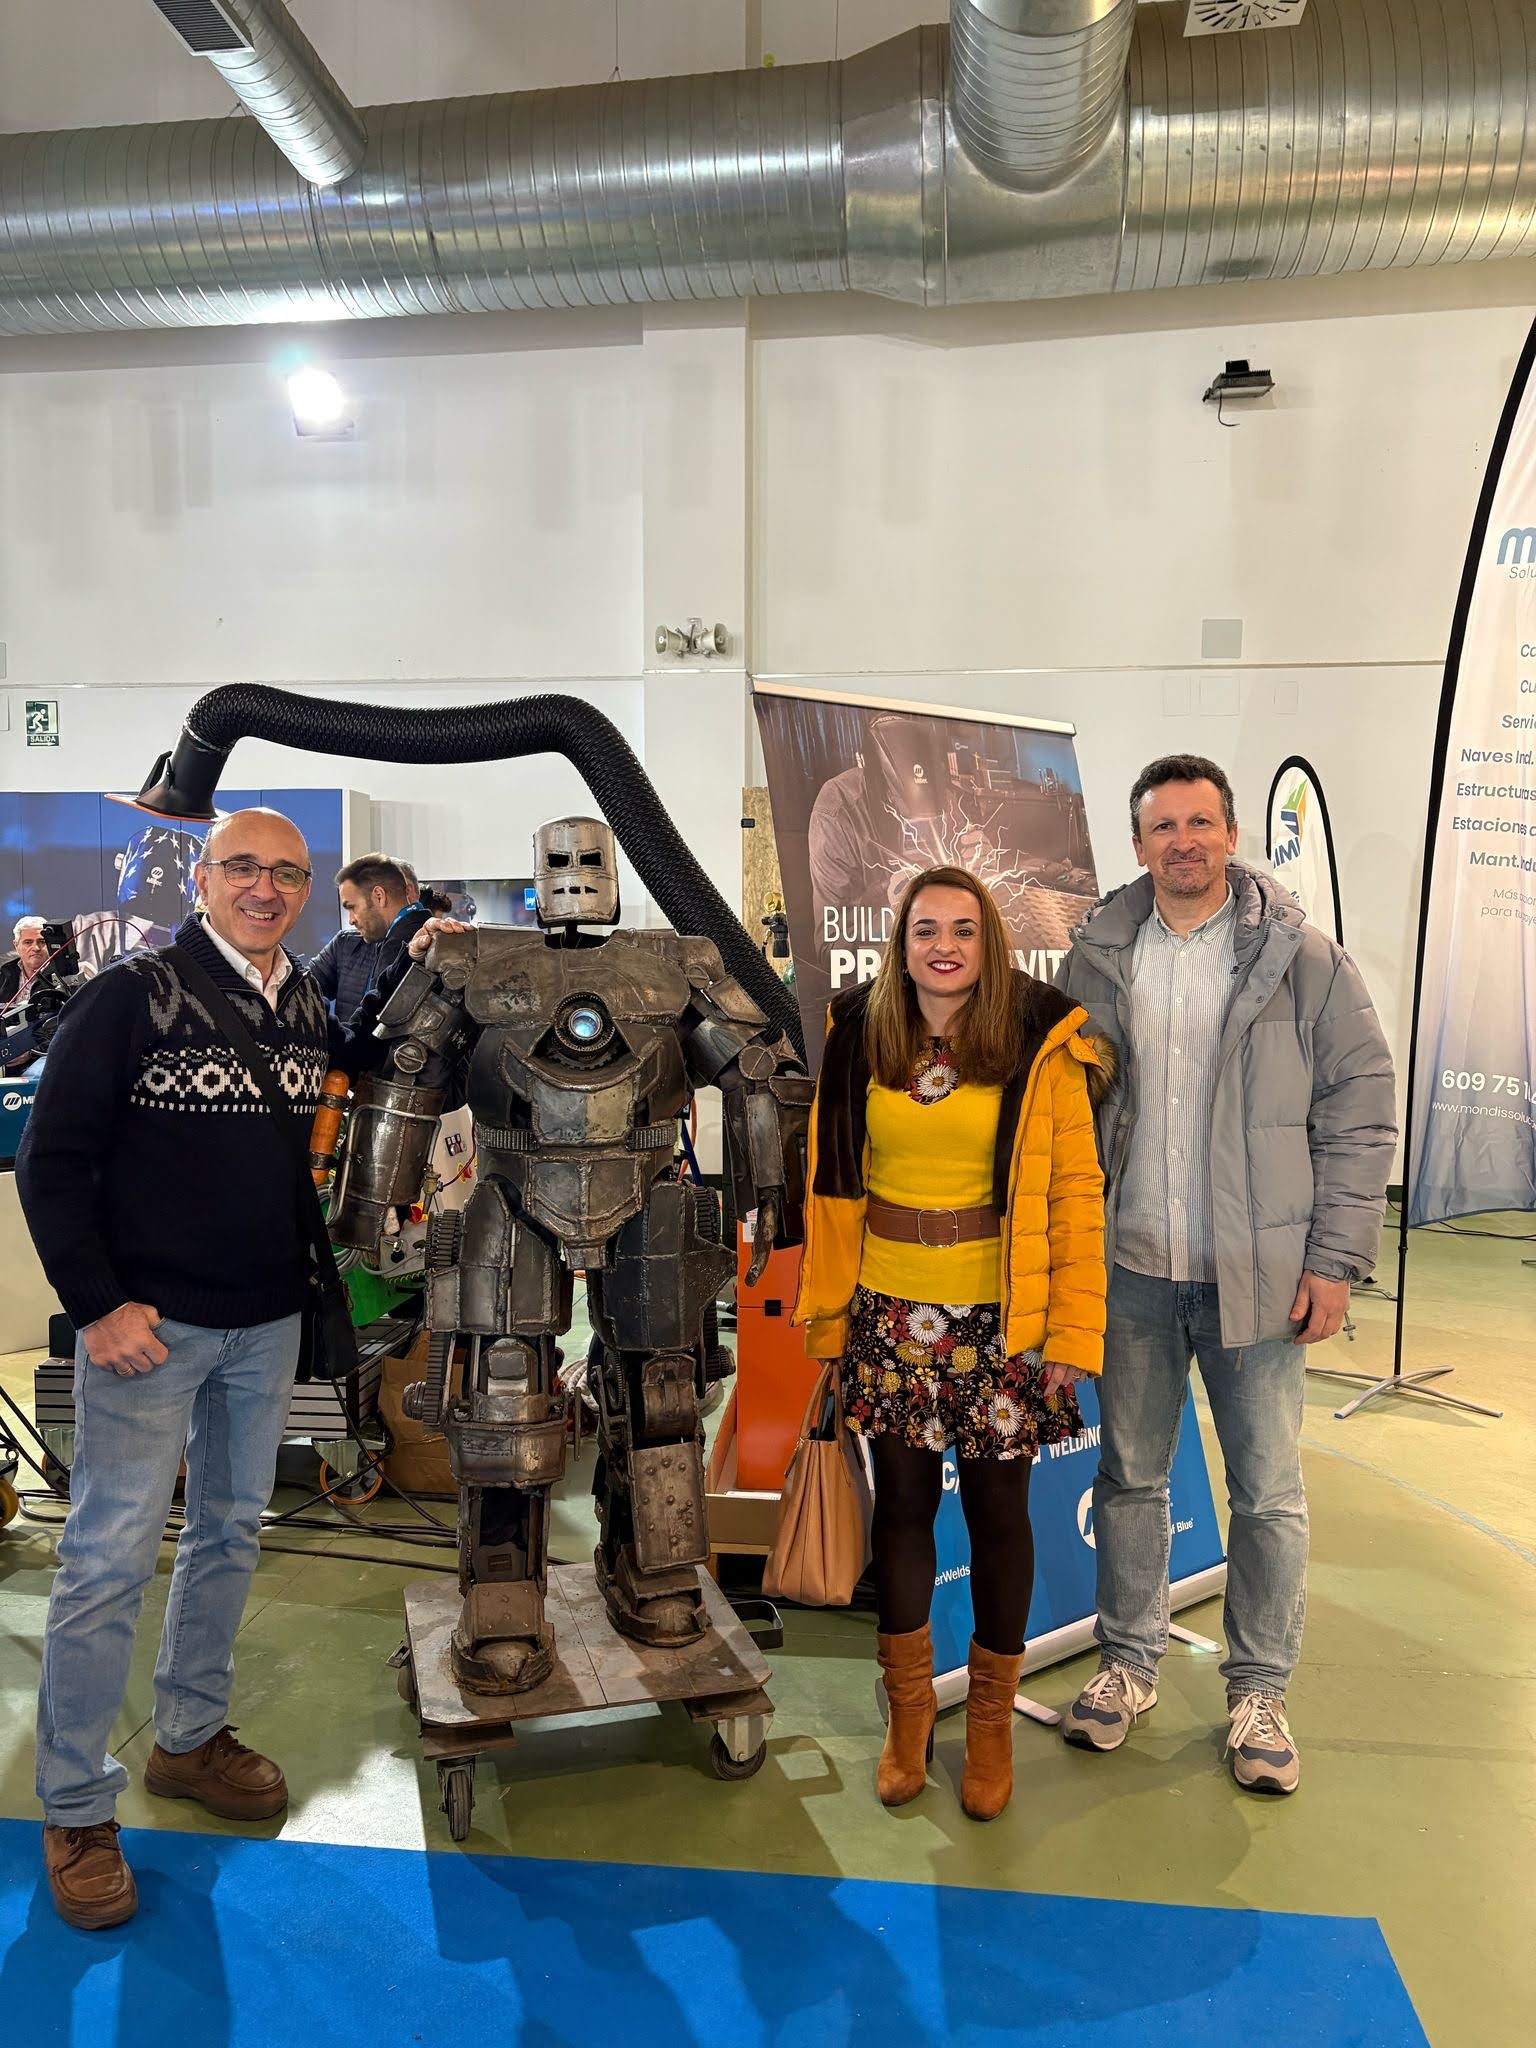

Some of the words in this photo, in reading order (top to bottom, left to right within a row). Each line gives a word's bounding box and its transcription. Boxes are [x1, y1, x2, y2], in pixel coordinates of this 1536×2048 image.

[1501, 714, 1536, 729] Servi
[1461, 748, 1513, 763] Naves
[1456, 783, 1536, 801] Estructuras
[1452, 816, 1527, 836] Estaciones
[1493, 888, 1518, 900] Más
[1480, 906, 1512, 918] para
[824, 906, 895, 943] BUILD
[1441, 1069, 1486, 1091] 609
[1176, 1520, 1194, 1533] Blue
